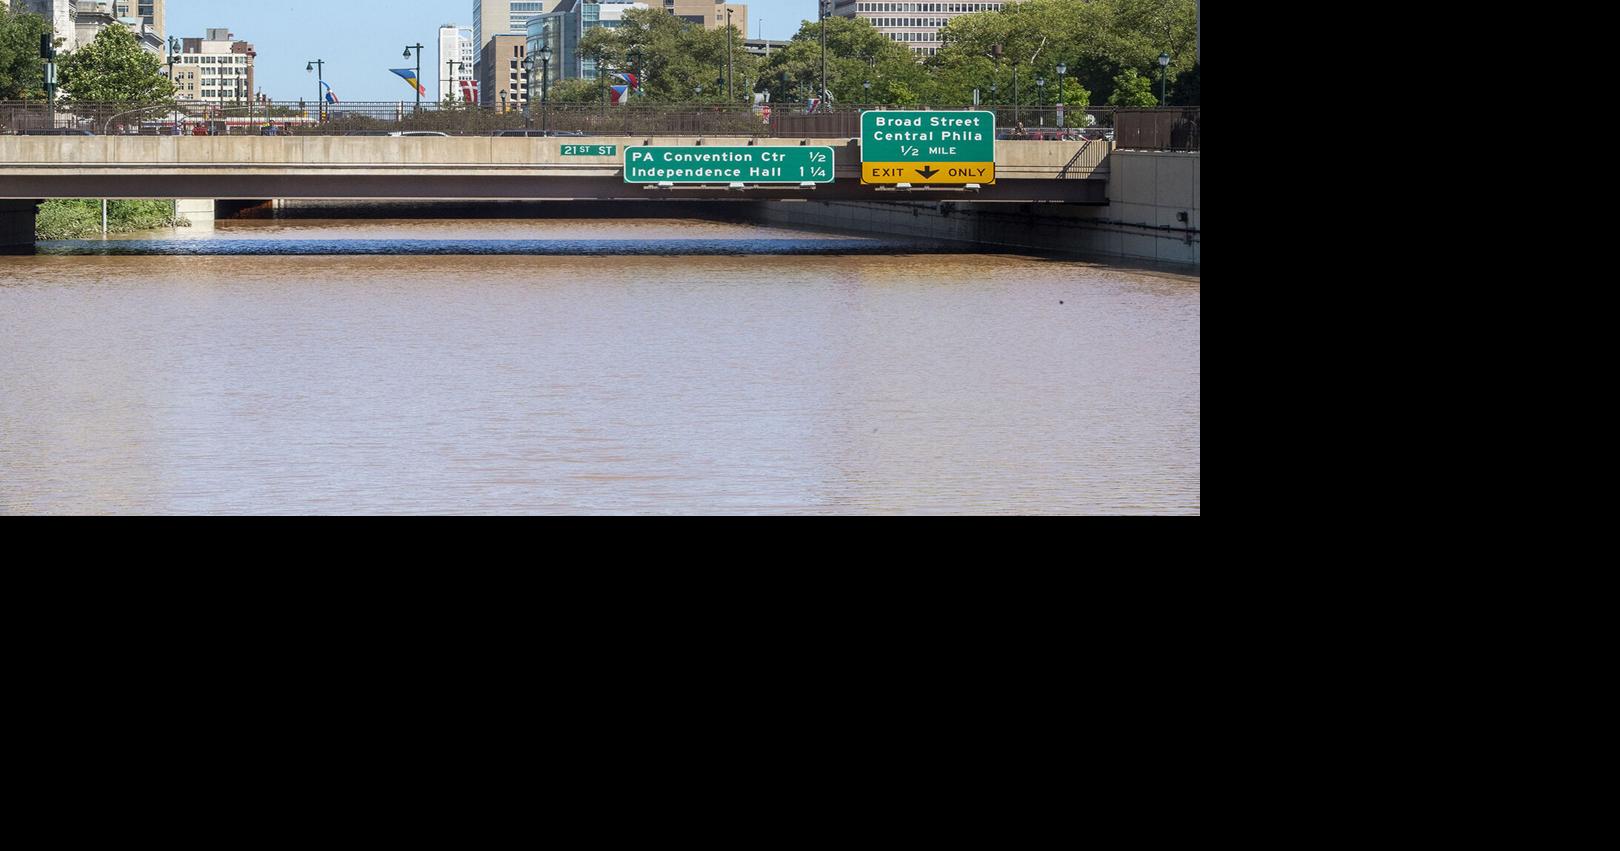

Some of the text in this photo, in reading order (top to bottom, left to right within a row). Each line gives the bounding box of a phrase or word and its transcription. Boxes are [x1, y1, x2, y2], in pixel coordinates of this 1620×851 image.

[876, 117, 980, 126] Broad Street
[874, 131, 982, 141] Central Phila
[598, 146, 613, 155] ST
[929, 147, 957, 155] MILE
[632, 152, 654, 162] PA
[664, 152, 752, 162] Convention
[761, 152, 785, 162] Ctr
[632, 167, 741, 179] Independence
[750, 167, 781, 177] Hall
[872, 168, 986, 177] EXIT ONLY
